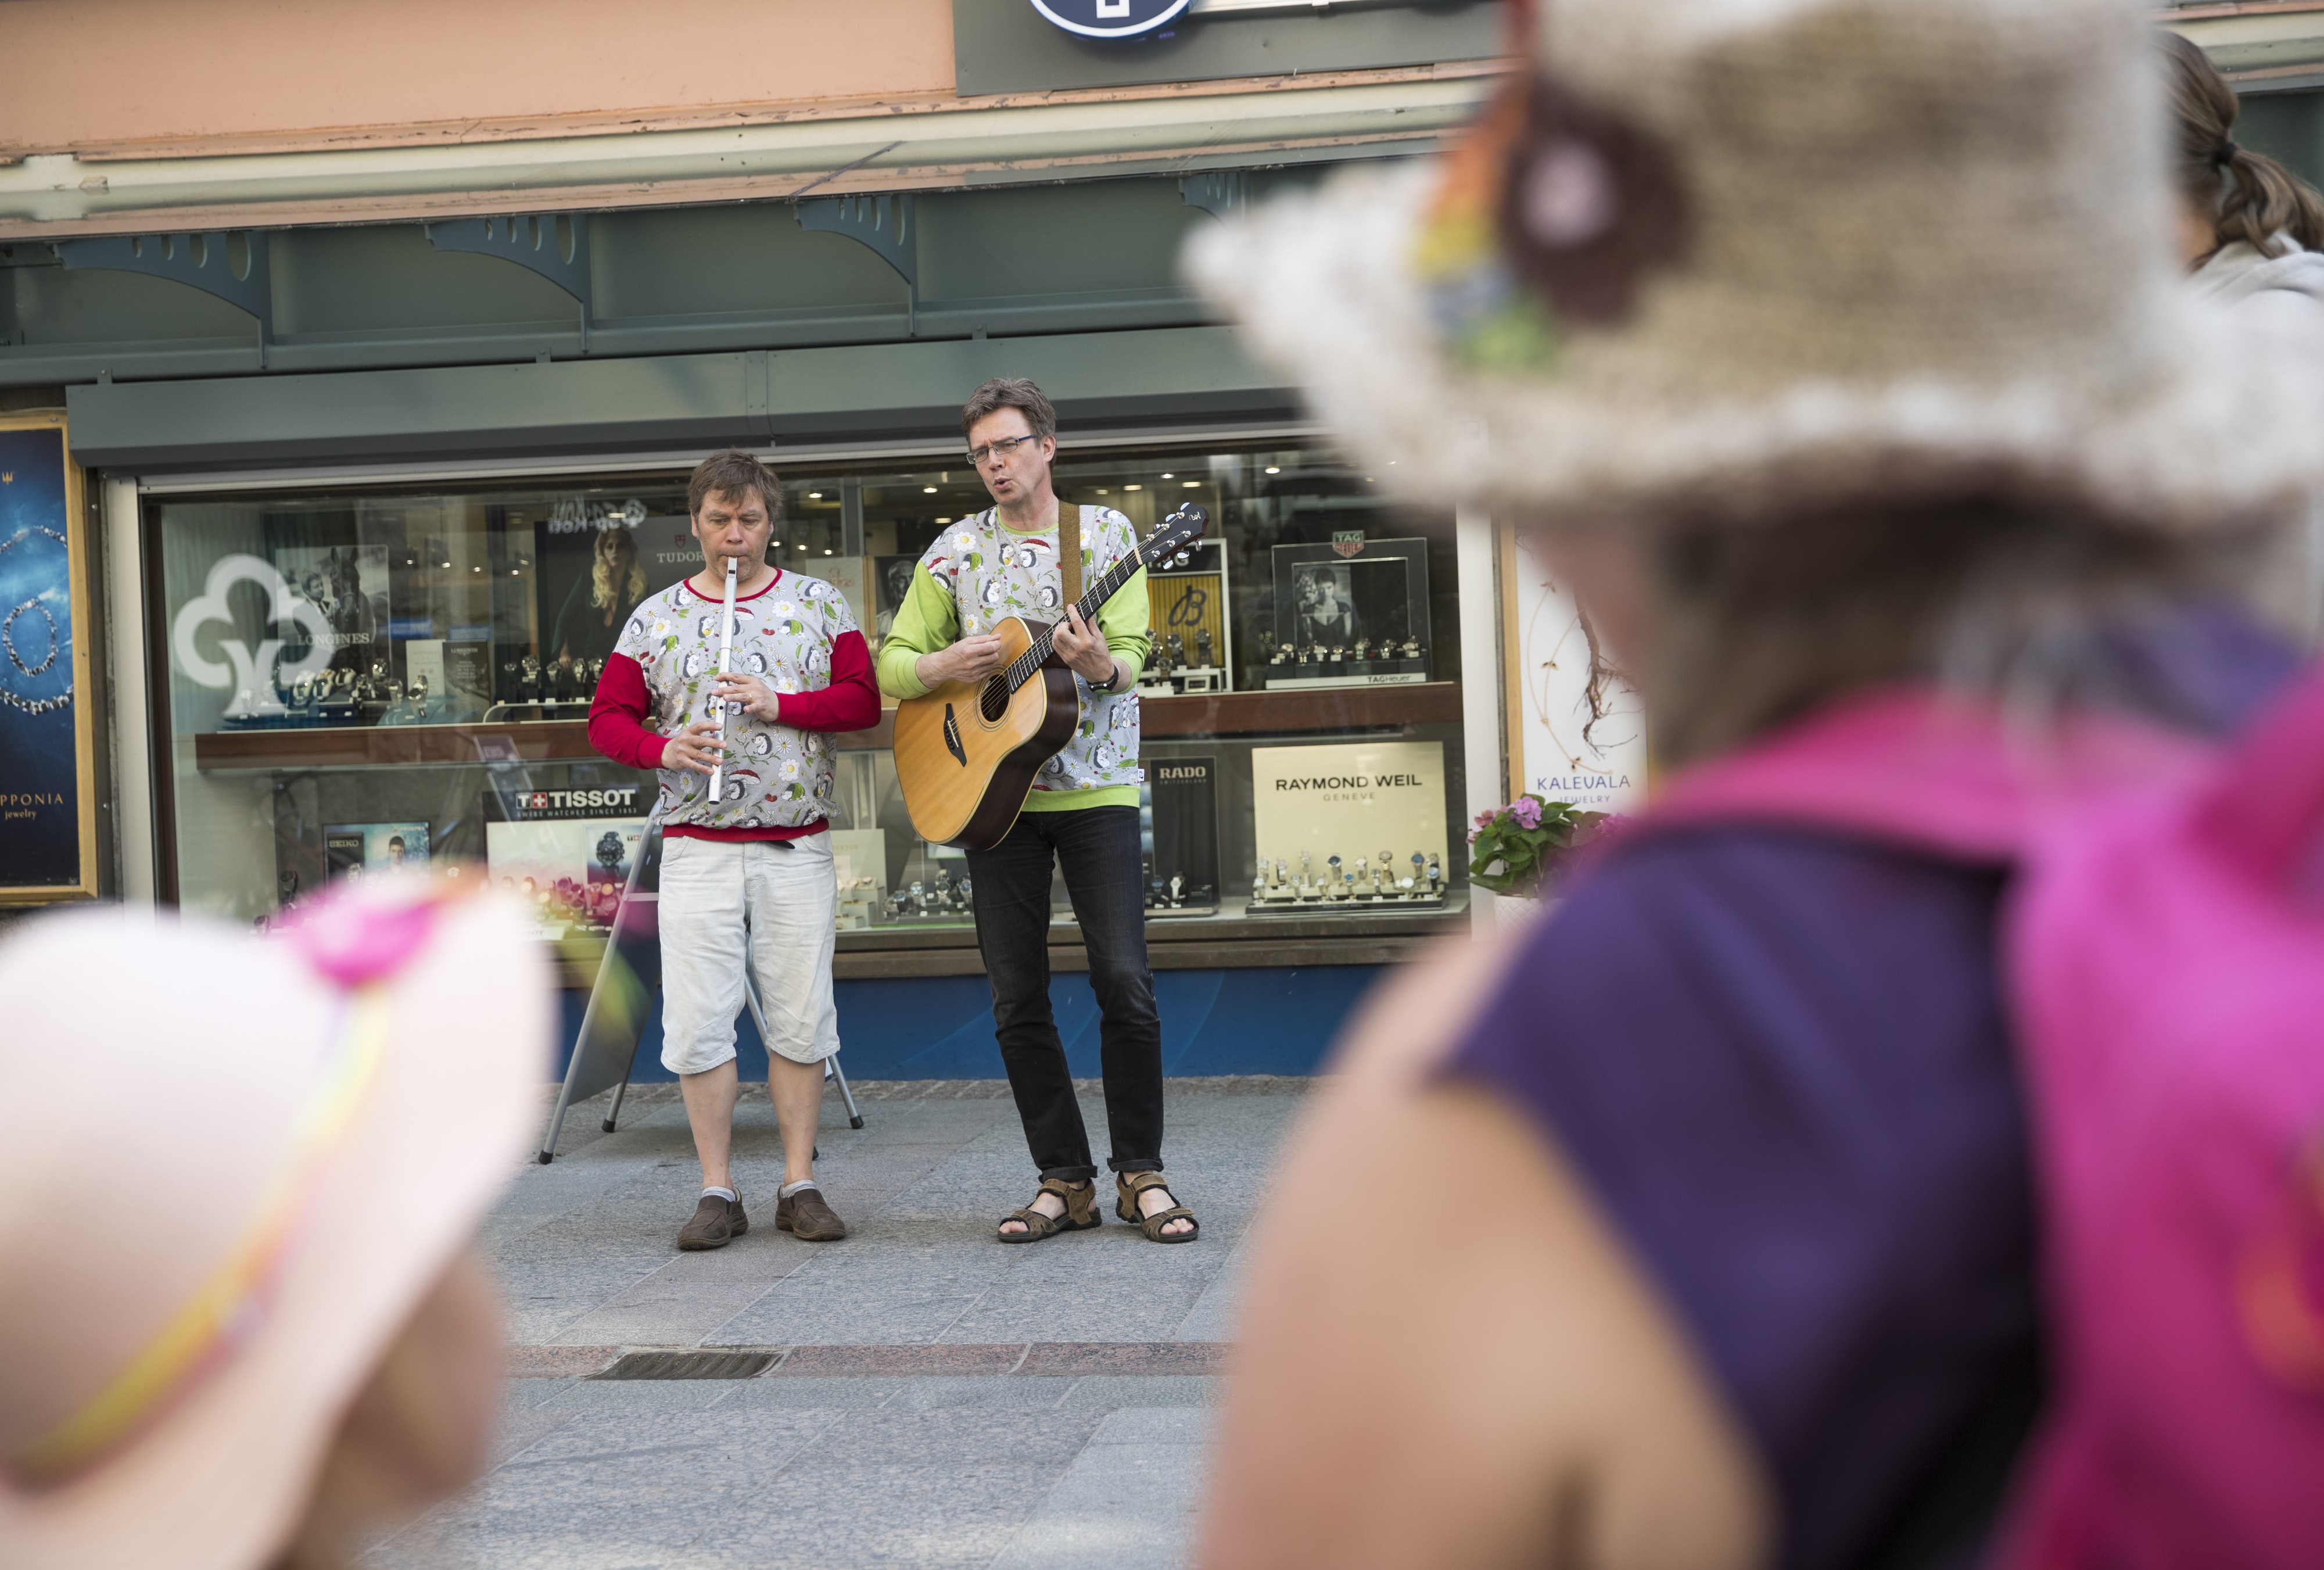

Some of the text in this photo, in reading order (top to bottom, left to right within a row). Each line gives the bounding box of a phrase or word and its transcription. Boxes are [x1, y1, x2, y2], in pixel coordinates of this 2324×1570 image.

[1336, 533, 1361, 542] TAG
[656, 551, 705, 563] TUDOR
[297, 632, 370, 646] LONGINES
[1159, 766, 1206, 779] RADO
[1276, 774, 1422, 791] RAYMOND WEIL
[548, 788, 636, 808] TISSOT
[1322, 792, 1376, 802] GENEVE
[5, 808, 37, 820] jewelry
[516, 806, 638, 819] SWISS WATCHES SINCE 1853
[329, 839, 359, 848] SEIKO
